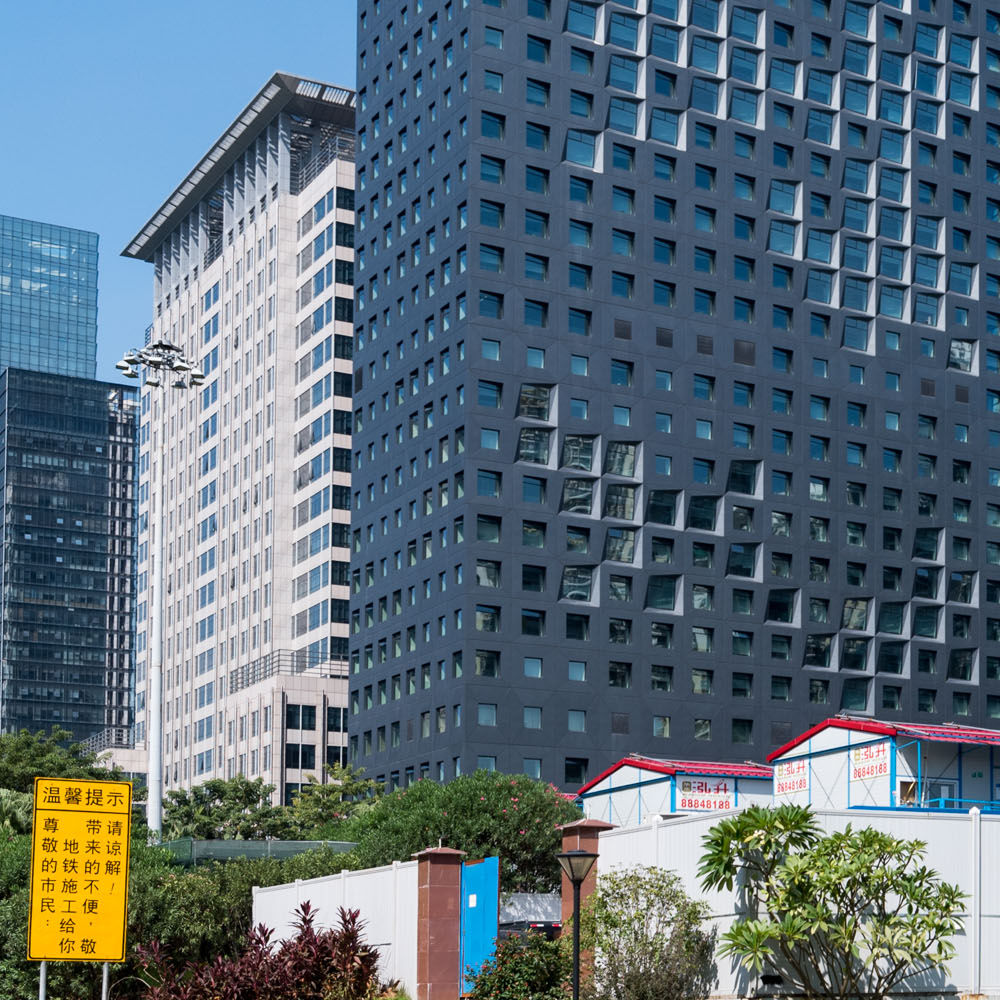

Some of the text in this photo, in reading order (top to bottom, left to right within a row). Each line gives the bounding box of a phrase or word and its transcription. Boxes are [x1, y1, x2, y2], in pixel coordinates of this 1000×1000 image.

[43, 786, 124, 807] 温馨提示
[681, 798, 730, 810] 88848188
